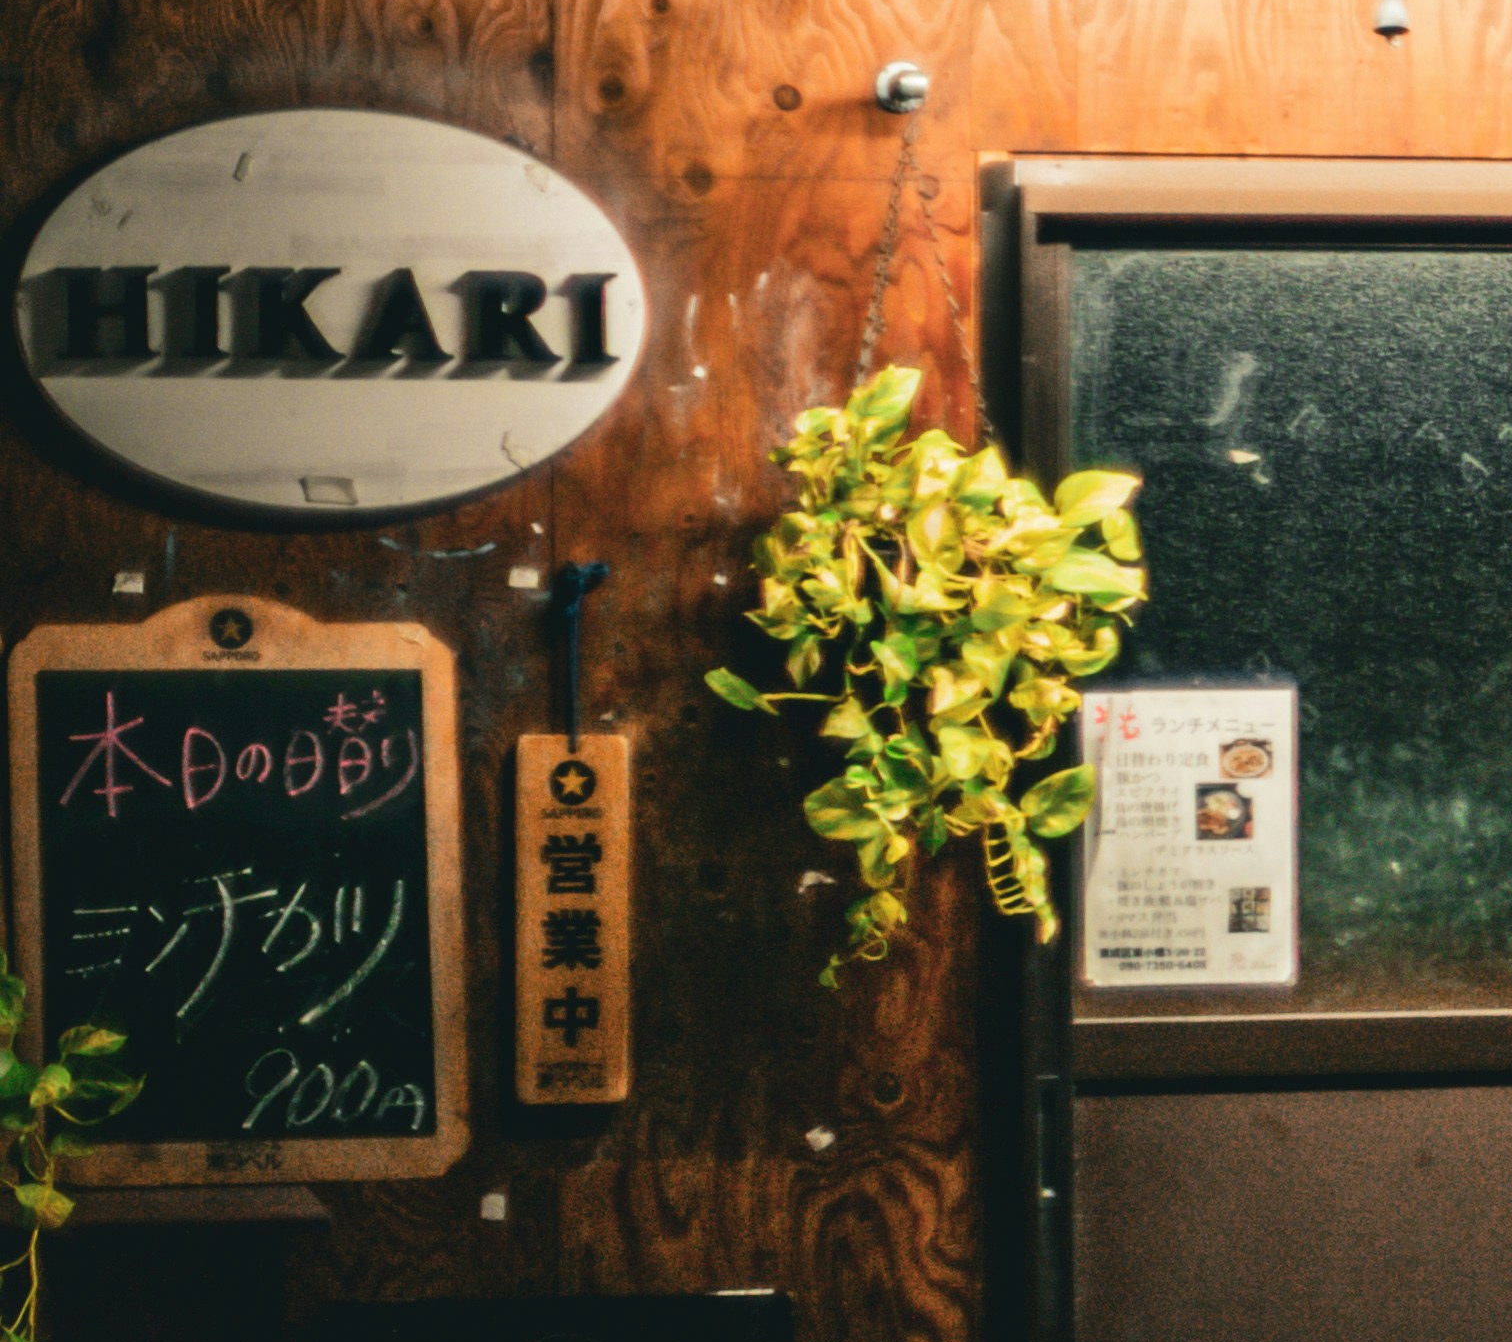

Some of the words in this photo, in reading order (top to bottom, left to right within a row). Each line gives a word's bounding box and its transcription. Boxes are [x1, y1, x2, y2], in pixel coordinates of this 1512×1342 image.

[50, 264, 620, 363] HIKARI
[1151, 717, 1277, 734] ランチメニュー
[540, 833, 602, 1049] 営業中
[243, 1048, 425, 1131] 900円
